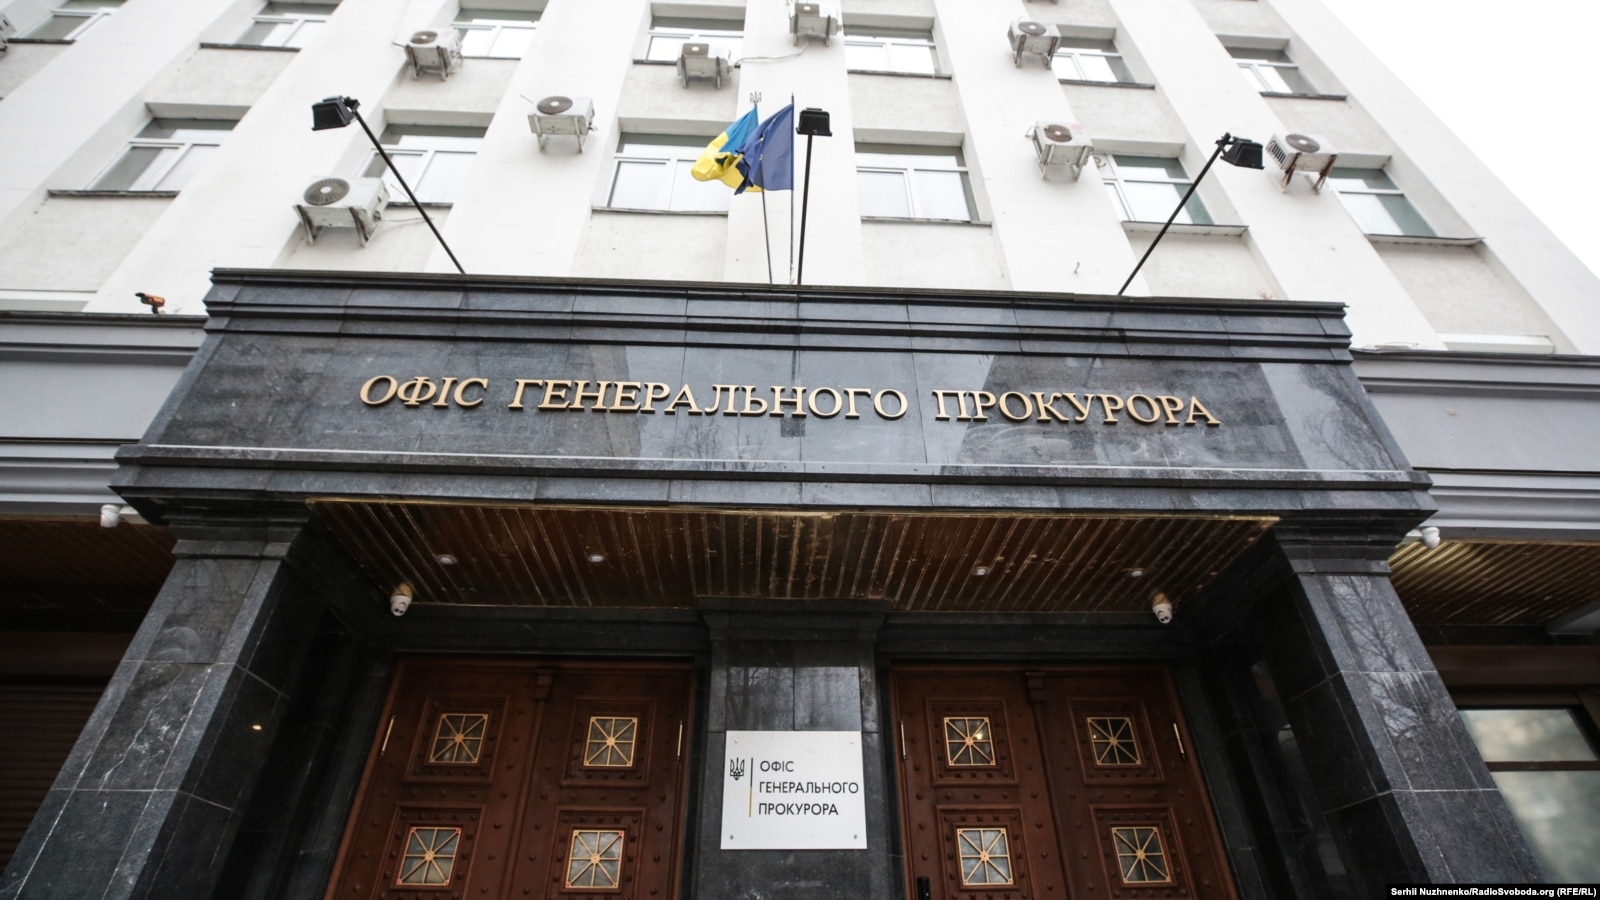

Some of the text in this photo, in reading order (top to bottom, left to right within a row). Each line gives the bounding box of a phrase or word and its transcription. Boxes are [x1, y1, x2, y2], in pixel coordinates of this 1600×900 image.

[359, 375, 1221, 426] ОФІС ГЕНЕРАЛЬНОГО ПРОКУРОРА
[759, 760, 795, 772] ОФІС
[758, 781, 859, 794] ГЕНЕРАЛЬНОГО
[758, 803, 839, 816] ПРОКУРОРА
